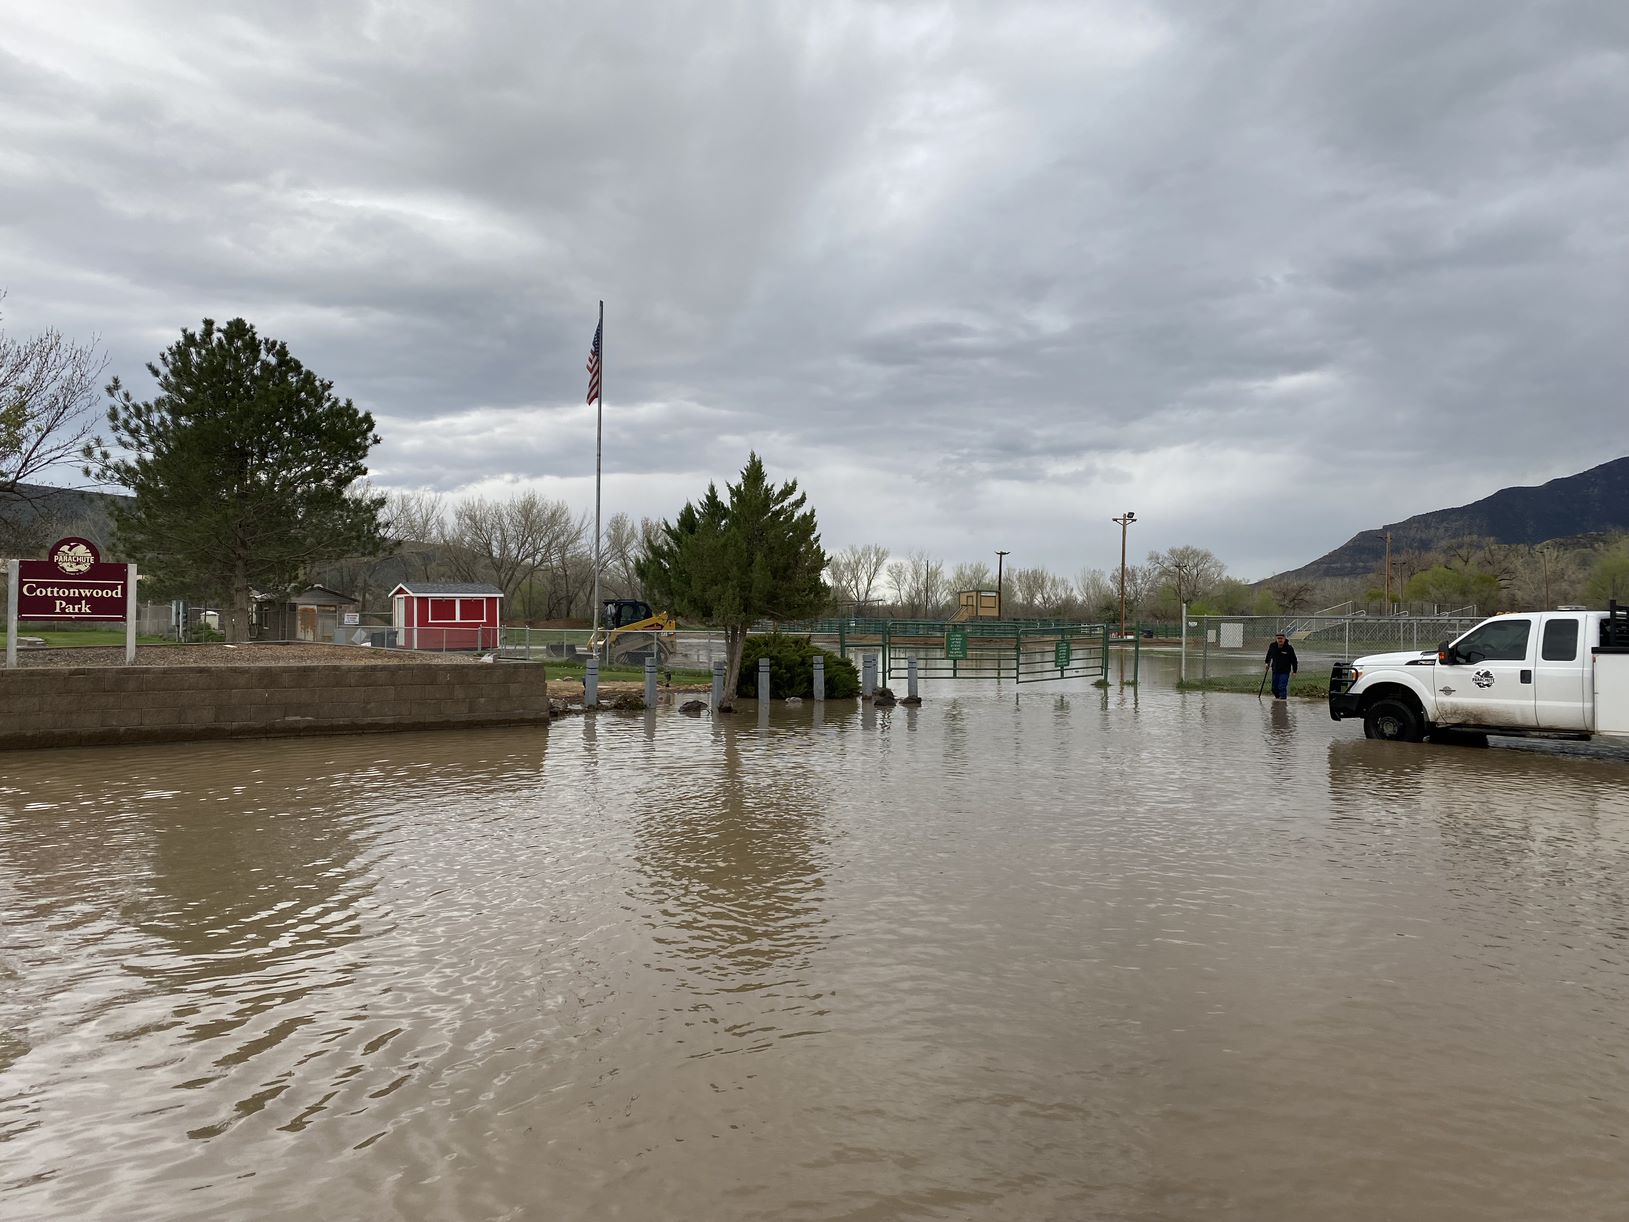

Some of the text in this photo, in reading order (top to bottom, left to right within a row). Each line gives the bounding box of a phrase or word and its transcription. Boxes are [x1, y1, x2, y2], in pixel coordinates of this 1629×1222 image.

[54, 555, 95, 564] PARACHUTE
[22, 583, 123, 598] Cottonwood
[54, 600, 92, 613] Park
